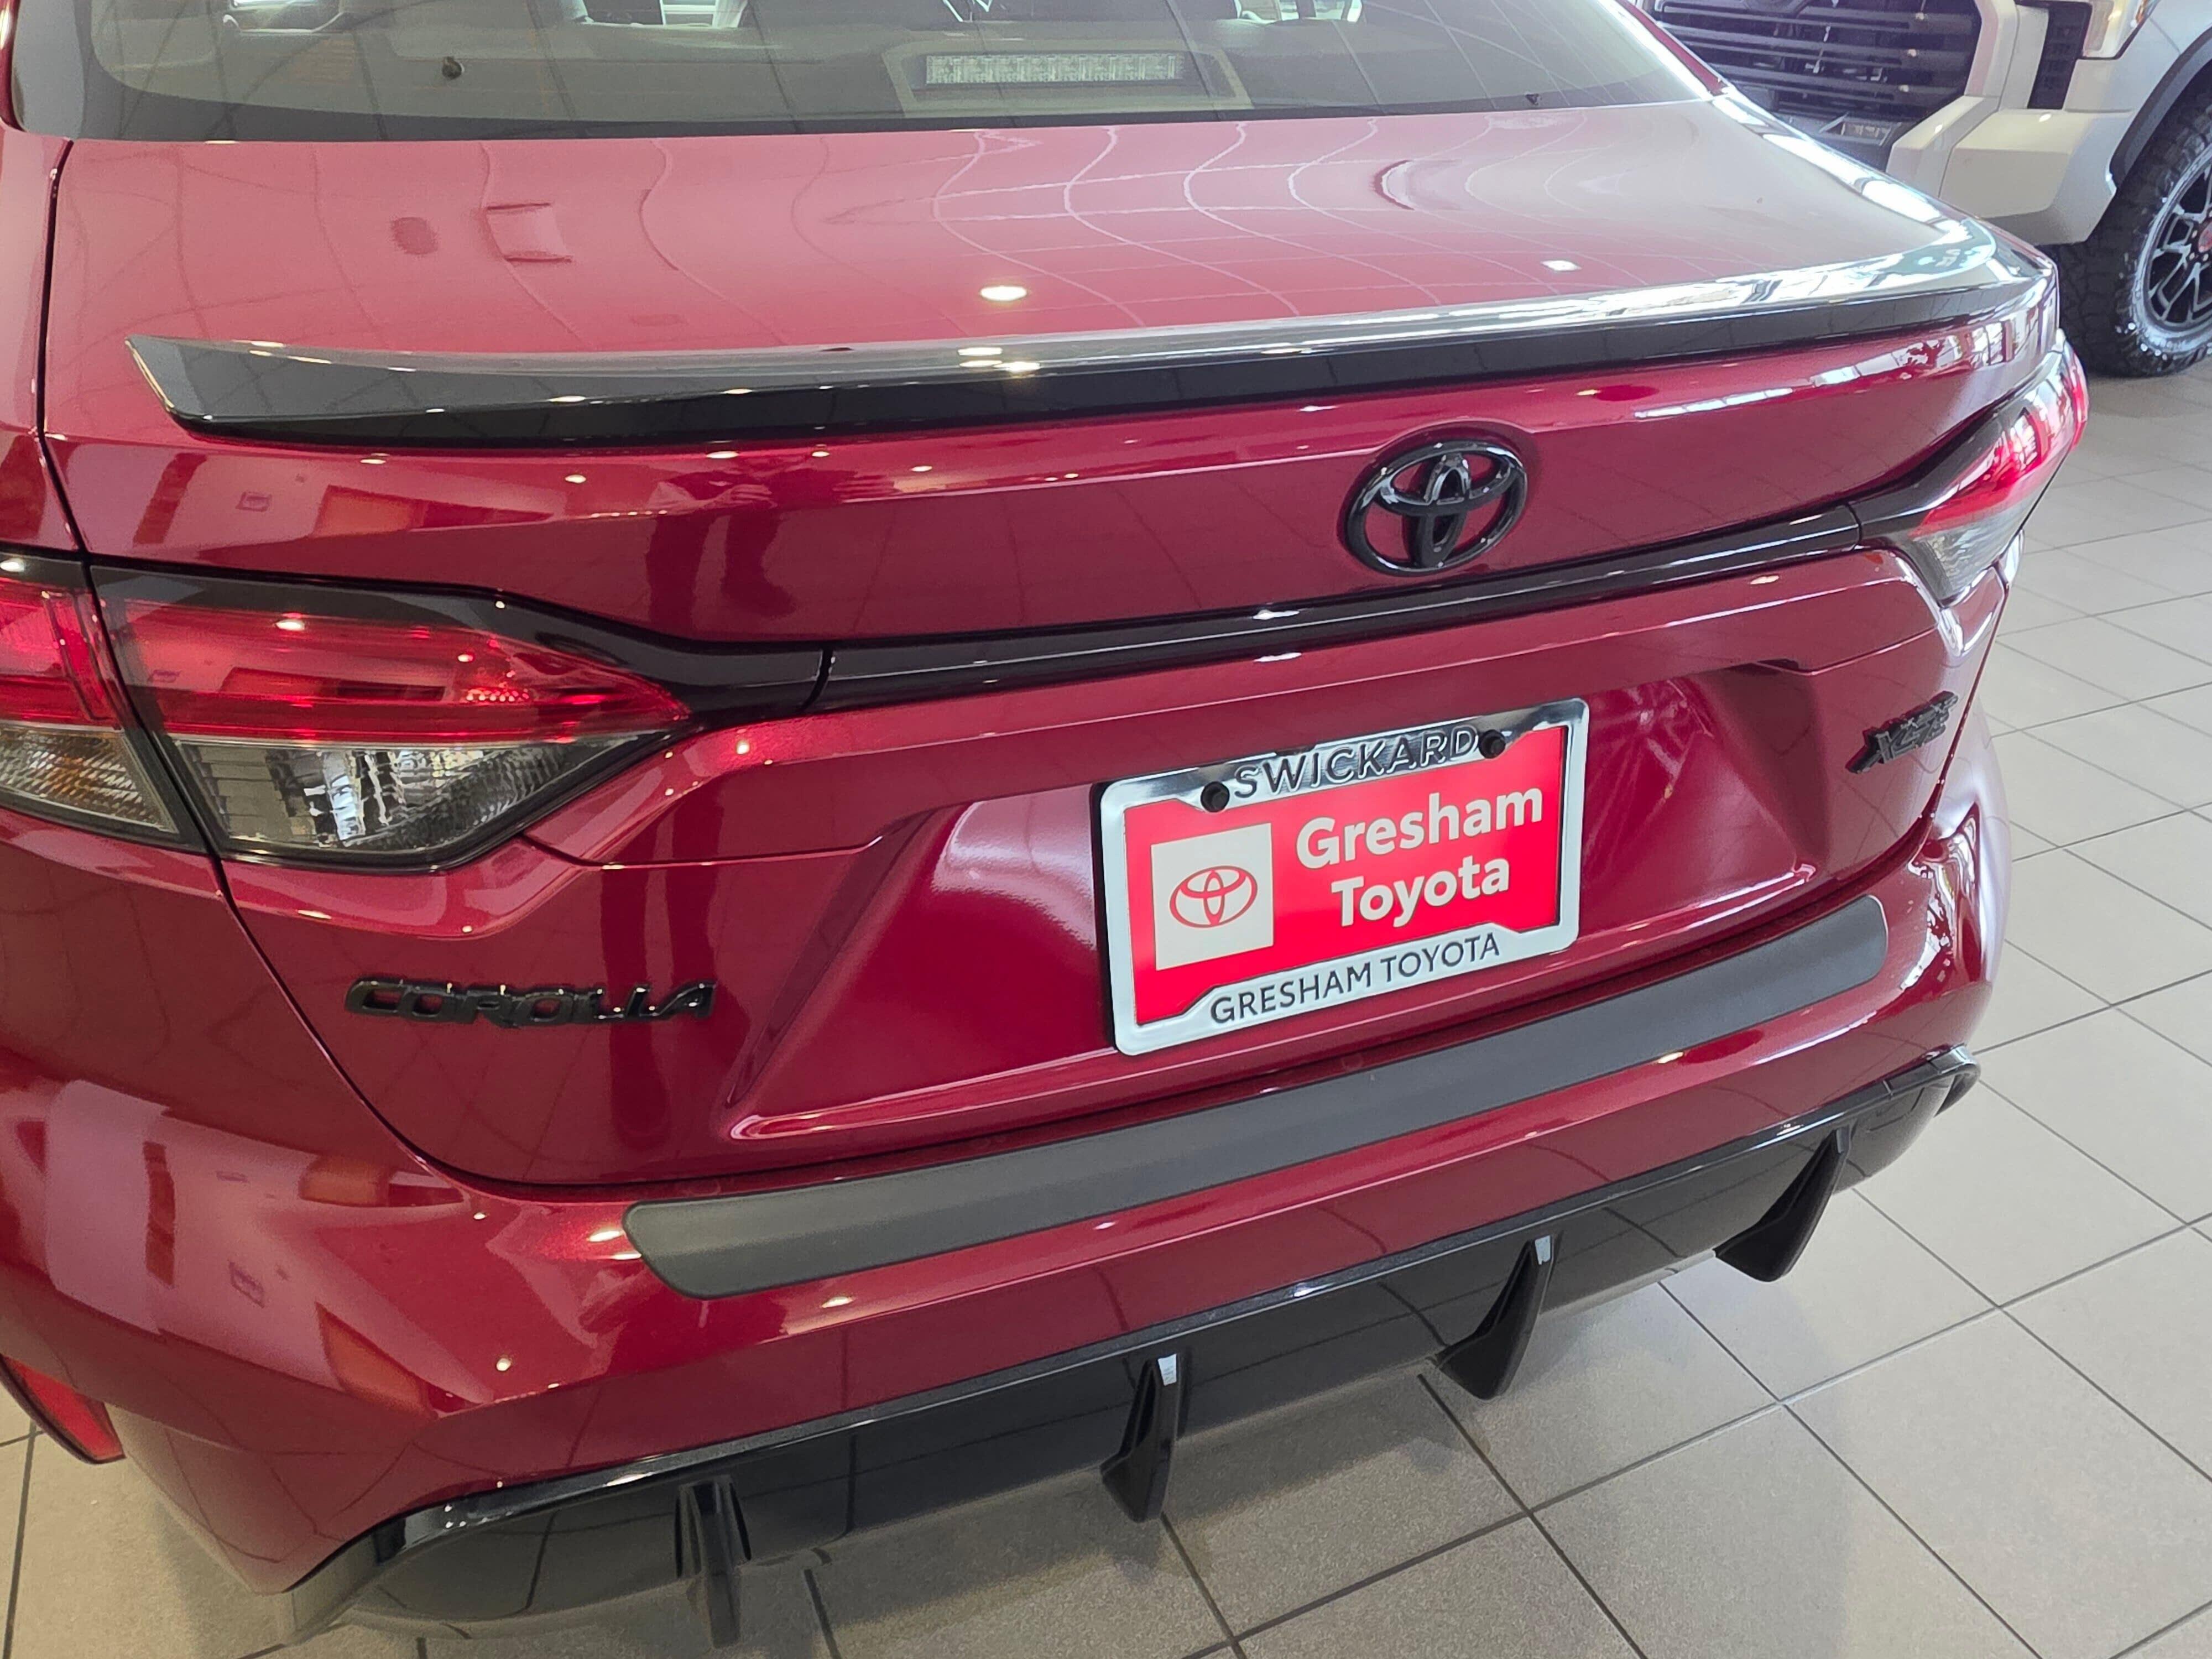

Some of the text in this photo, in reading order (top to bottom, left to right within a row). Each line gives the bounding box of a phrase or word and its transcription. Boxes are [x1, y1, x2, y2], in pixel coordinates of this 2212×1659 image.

[1233, 726, 1480, 800] SWICKARD
[1296, 787, 1543, 870] Gresham
[1332, 857, 1510, 927] Toyota
[345, 977, 717, 1028] COROLLA
[1211, 932, 1500, 1022] GRESHAM TOYOTA
